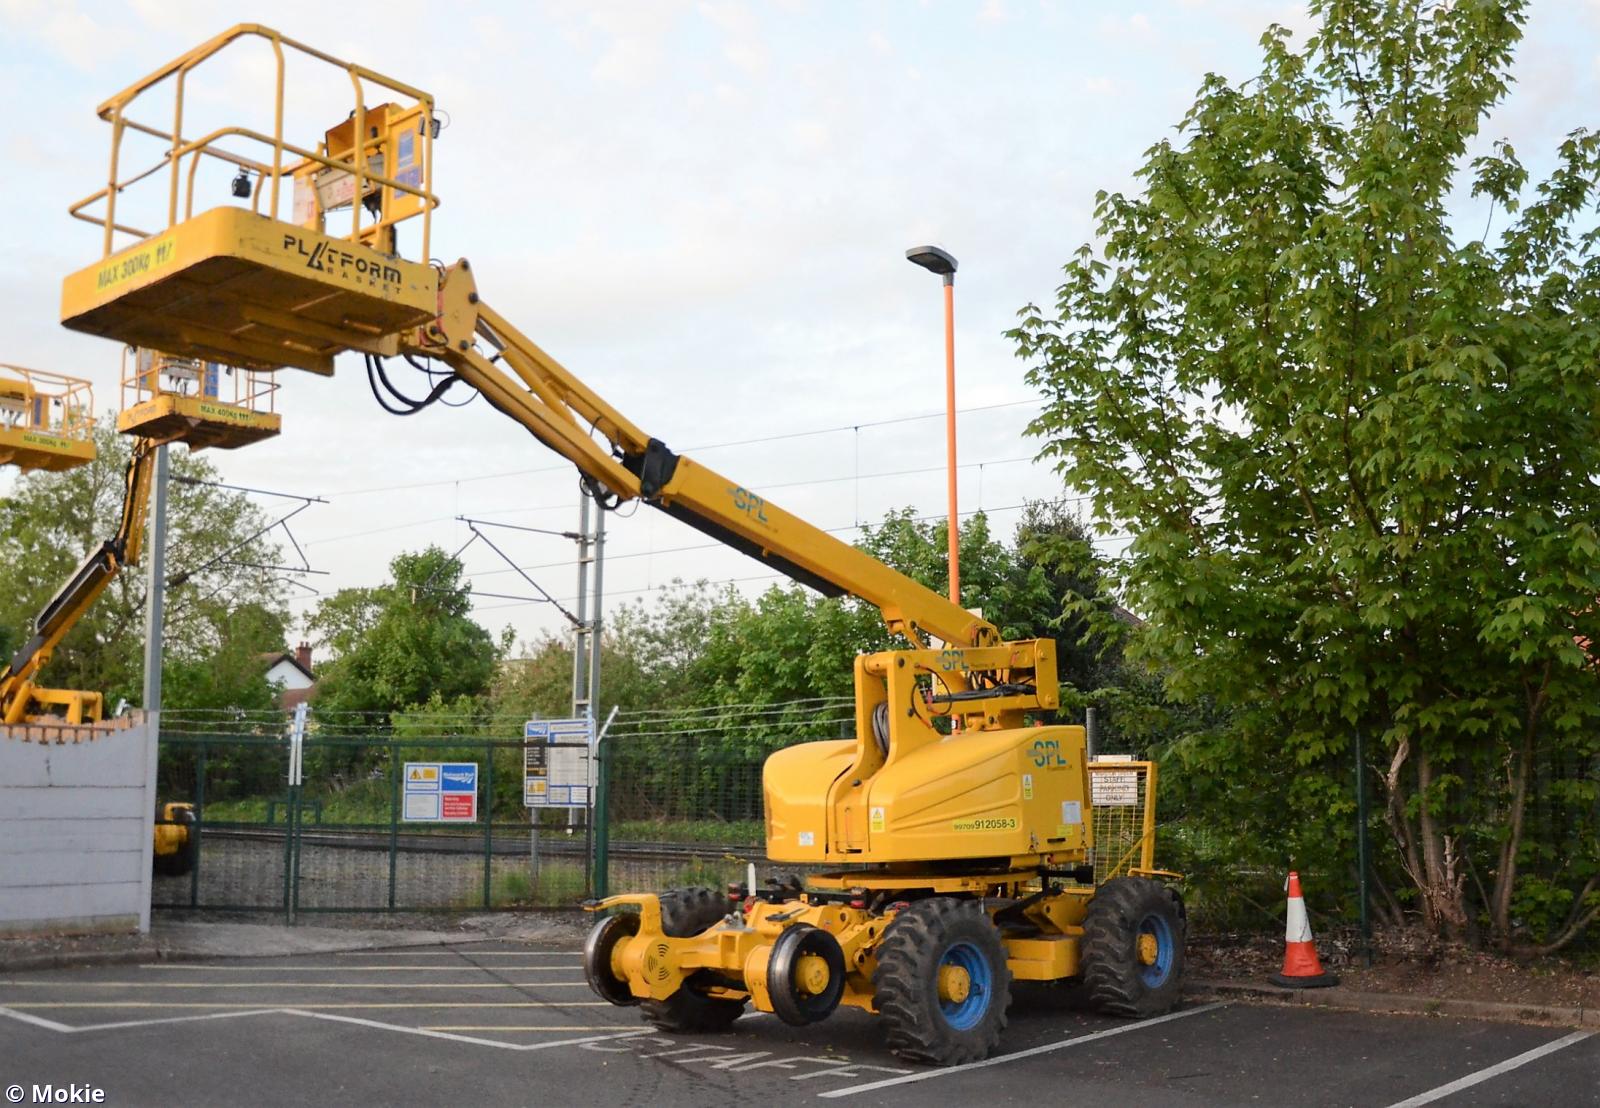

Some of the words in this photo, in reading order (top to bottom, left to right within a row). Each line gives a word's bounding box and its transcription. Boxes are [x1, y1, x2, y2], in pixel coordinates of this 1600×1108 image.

[284, 234, 401, 284] PLATFORM
[98, 264, 119, 289] MAX
[734, 486, 768, 524] SPL
[942, 650, 969, 671] SPL
[1033, 740, 1067, 768] SPL
